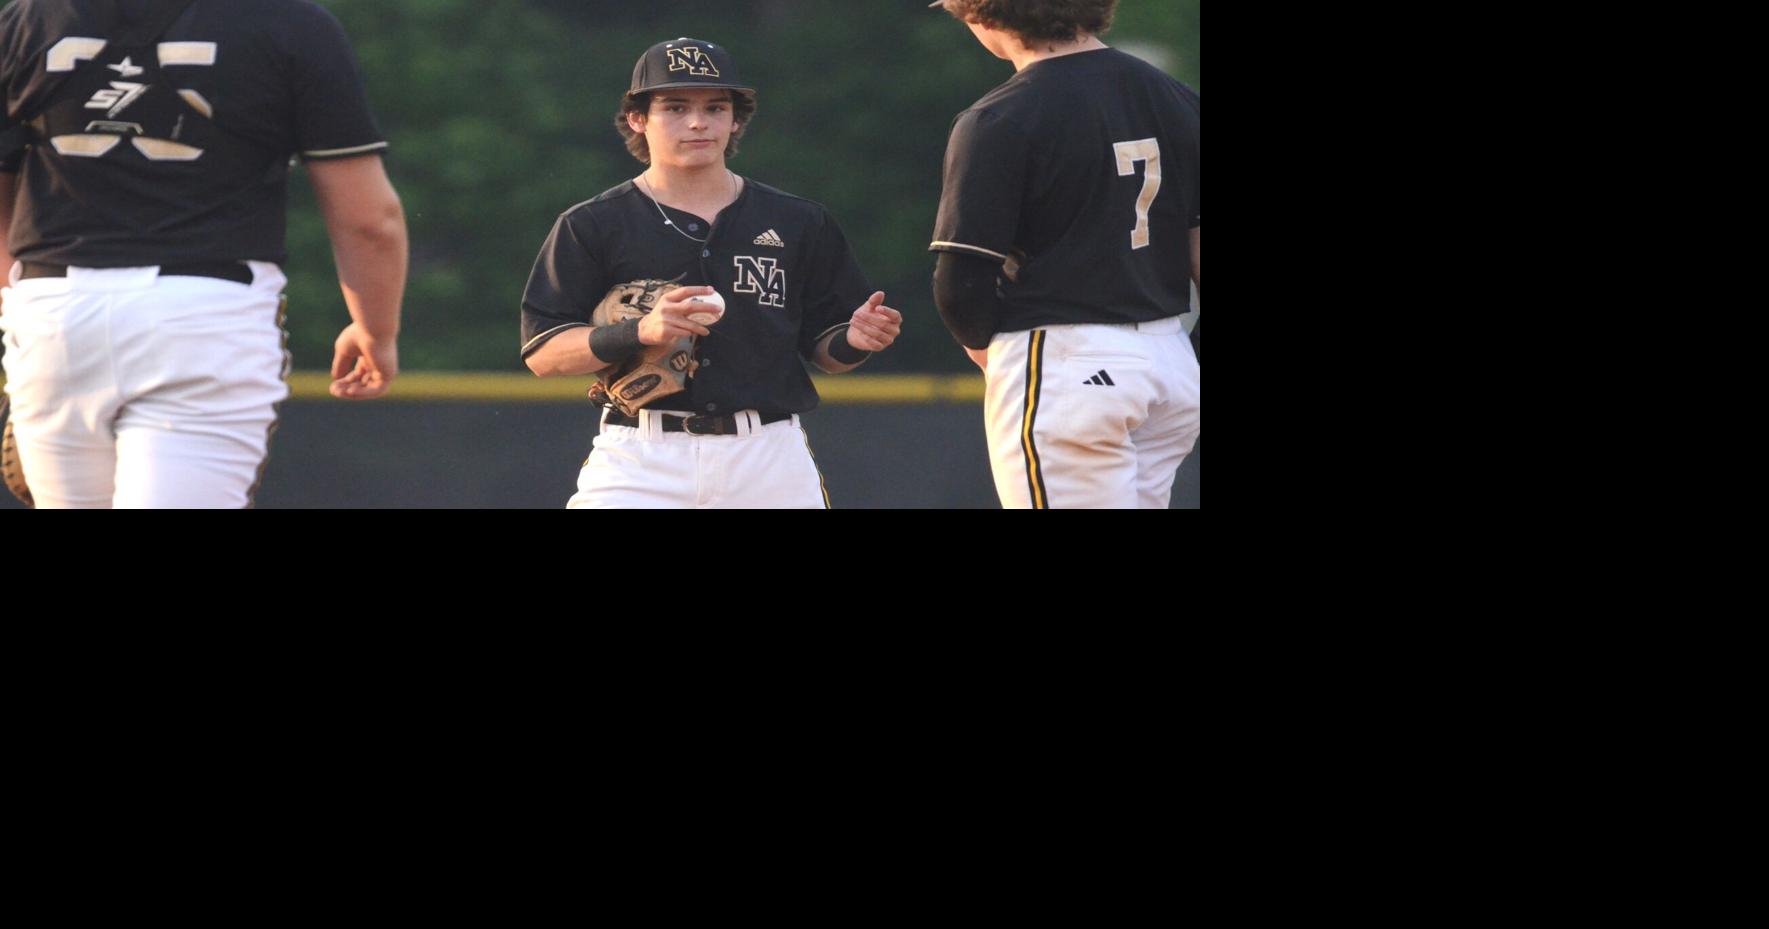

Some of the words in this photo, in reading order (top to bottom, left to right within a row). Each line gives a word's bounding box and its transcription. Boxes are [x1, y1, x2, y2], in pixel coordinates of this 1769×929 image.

[667, 46, 719, 77] NA
[1112, 137, 1162, 250] 7
[734, 255, 785, 307] NA
